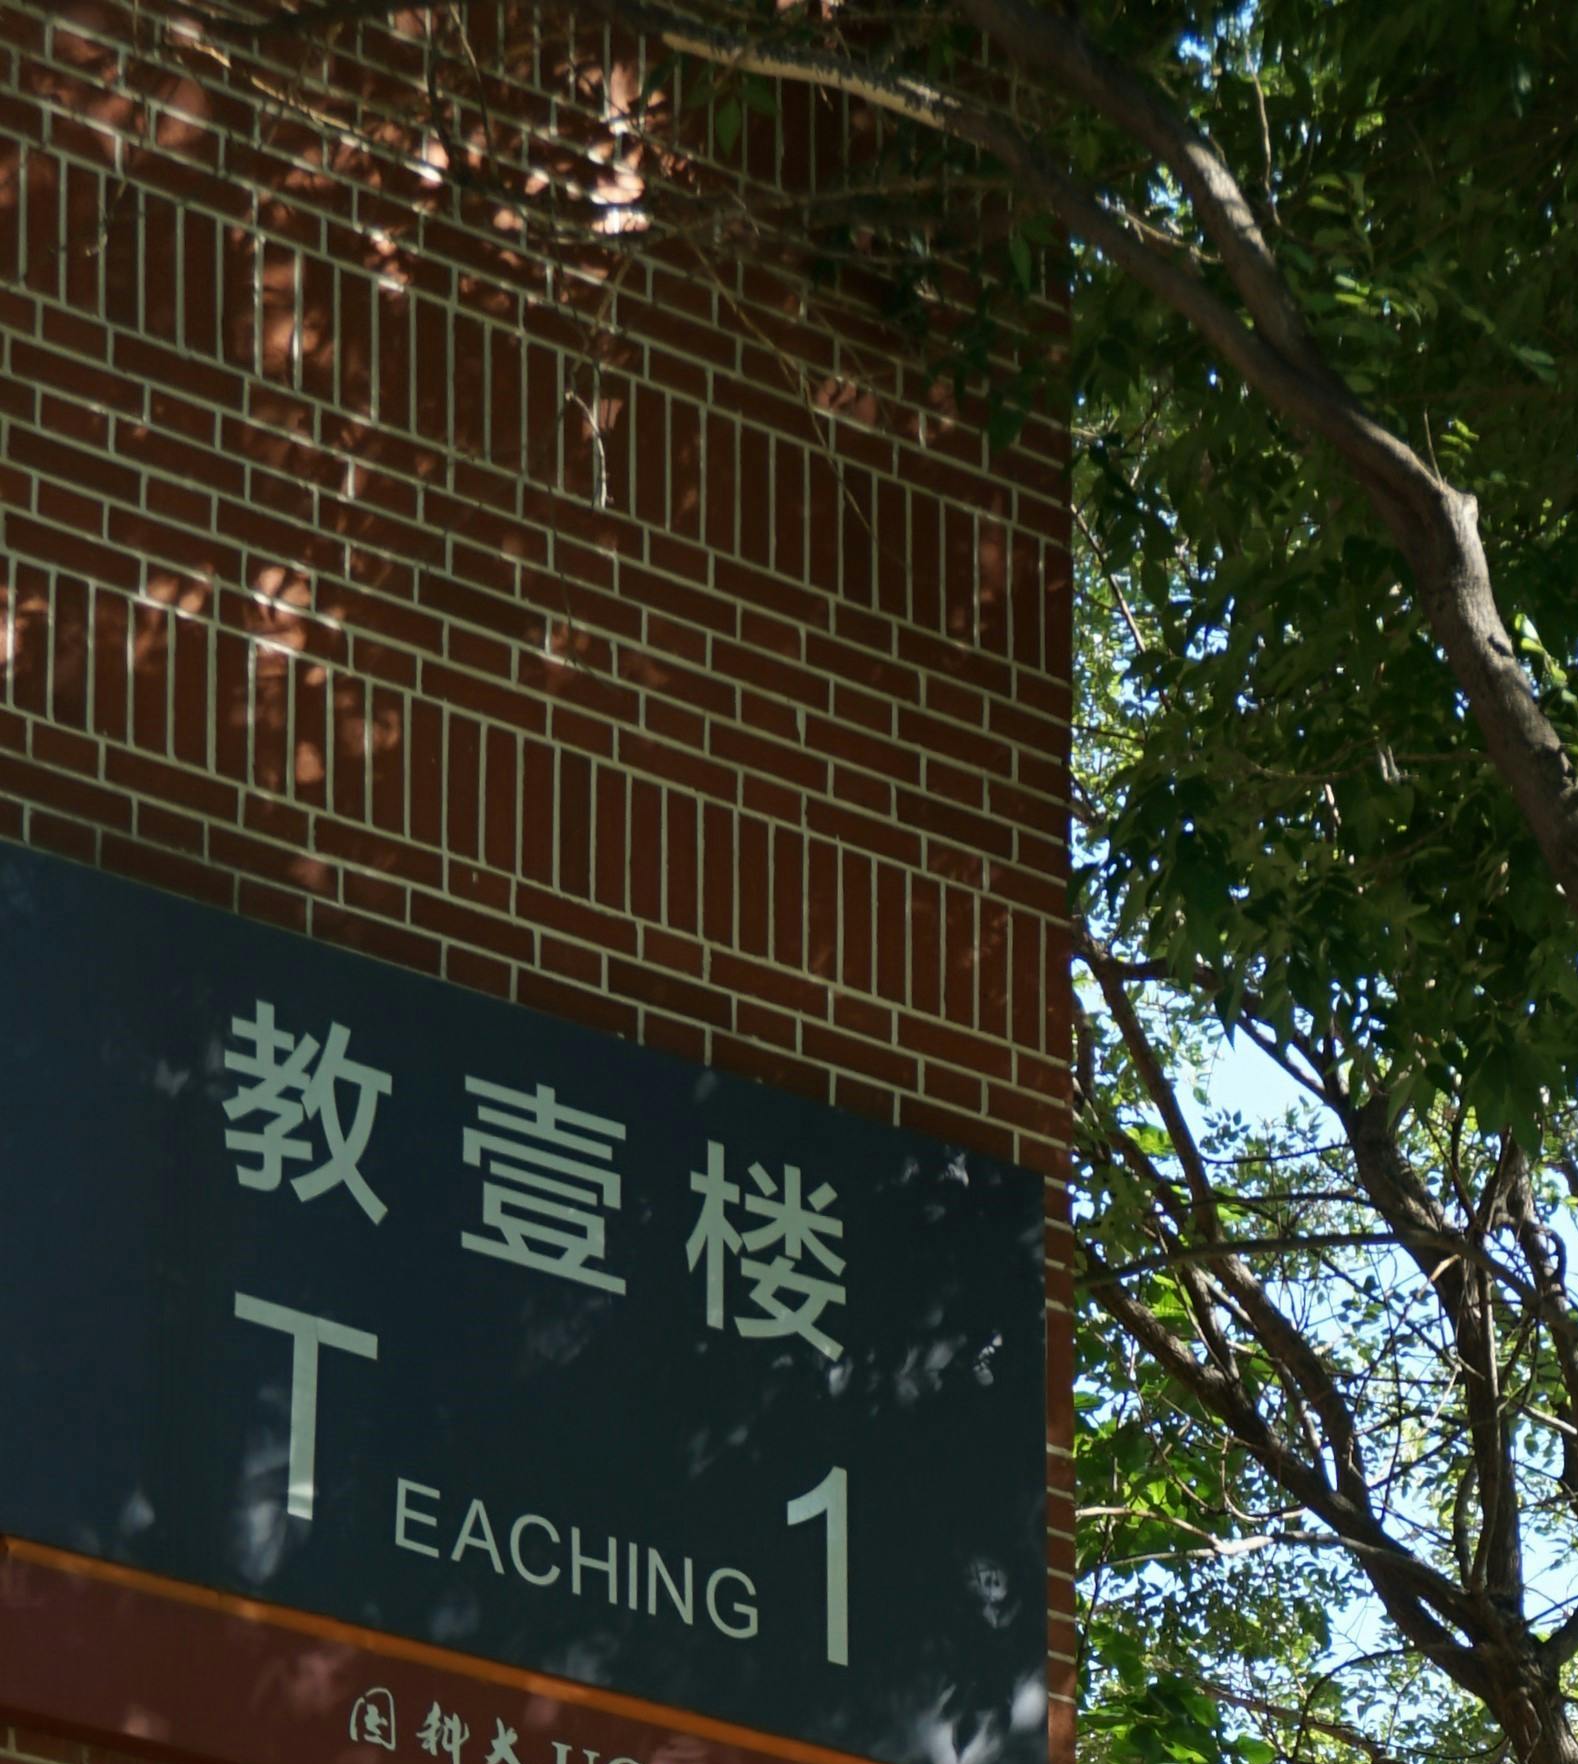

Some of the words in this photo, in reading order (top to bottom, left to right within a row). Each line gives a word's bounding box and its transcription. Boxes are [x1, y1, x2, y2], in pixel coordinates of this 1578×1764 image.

[222, 999, 847, 1362] 教壹楼
[786, 1466, 849, 1666] 1
